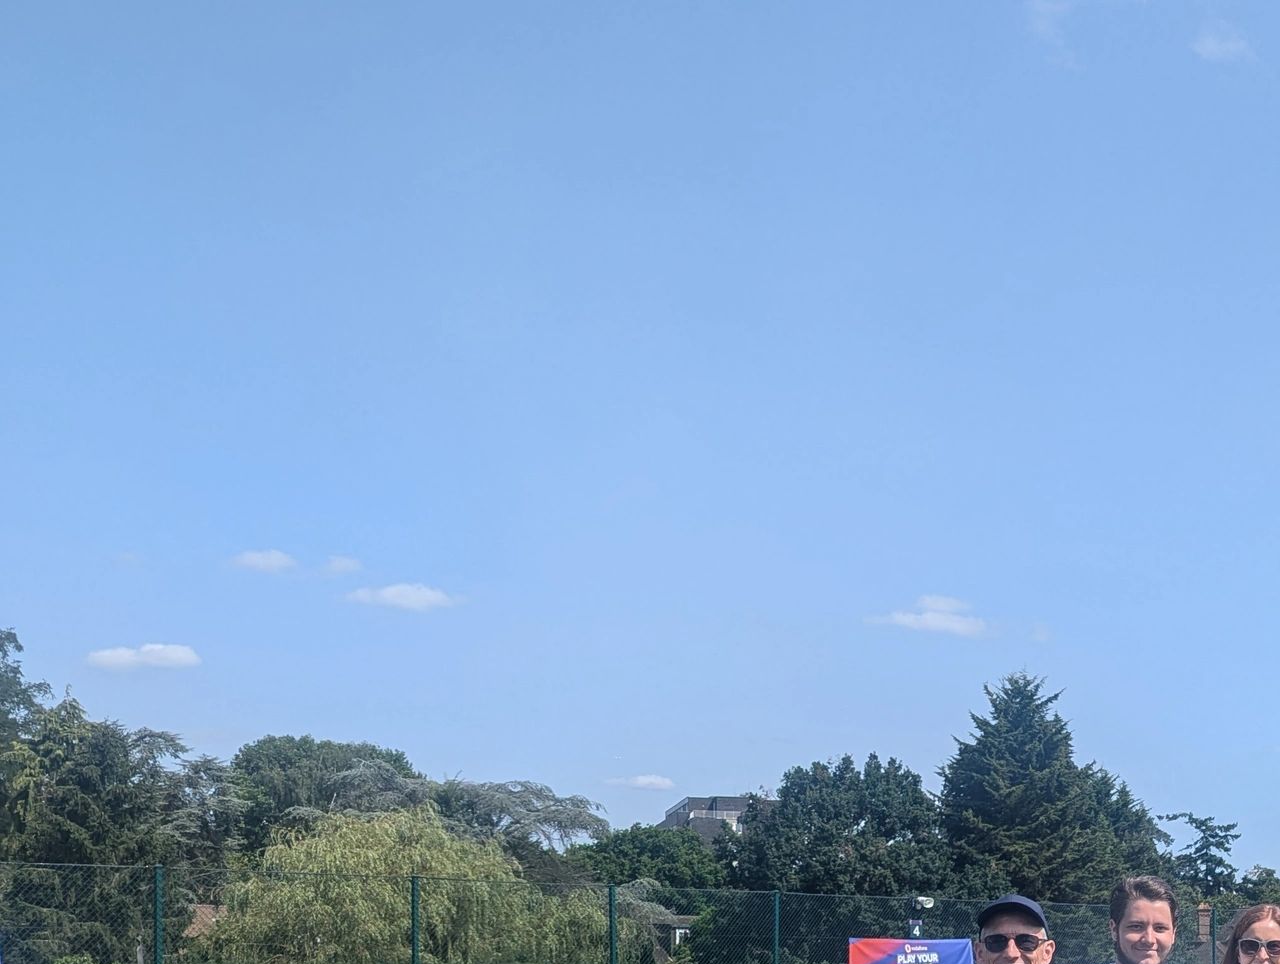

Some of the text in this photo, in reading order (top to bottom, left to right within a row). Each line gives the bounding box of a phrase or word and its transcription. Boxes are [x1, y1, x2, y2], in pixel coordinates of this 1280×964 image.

[913, 925, 920, 936] 4
[897, 953, 939, 964] PLAY YOUR
